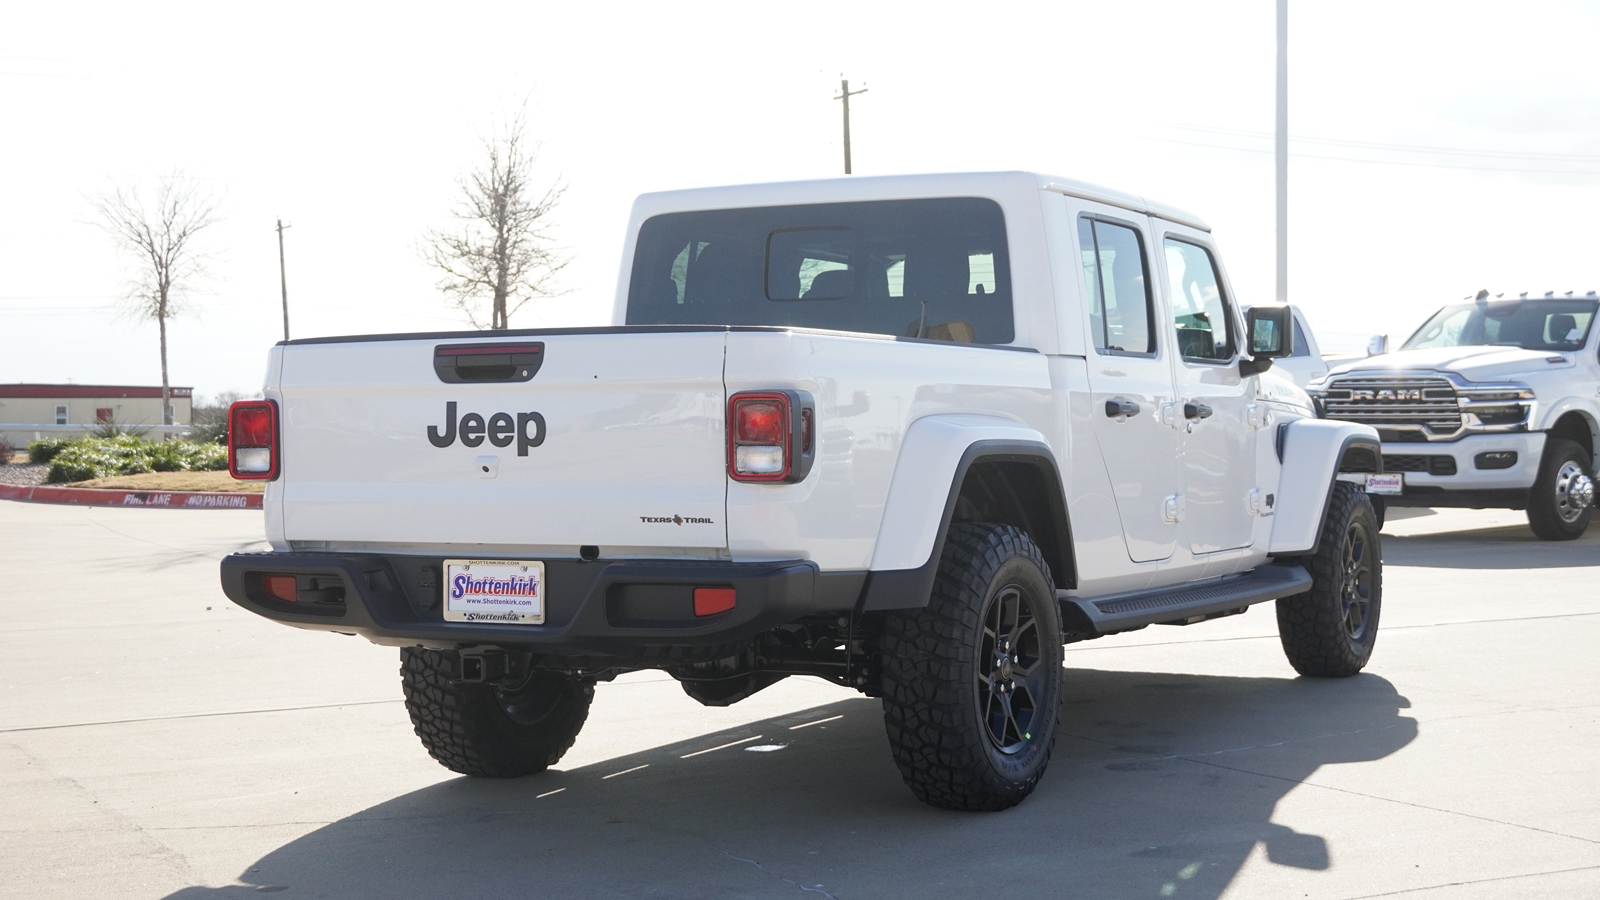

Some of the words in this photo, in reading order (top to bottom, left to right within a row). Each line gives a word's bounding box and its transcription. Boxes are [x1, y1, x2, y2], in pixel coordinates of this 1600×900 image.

[1353, 389, 1420, 400] RAM
[427, 401, 546, 457] Jeep
[146, 494, 172, 505] LANE
[187, 494, 202, 505] NO
[203, 495, 247, 507] PARKING
[452, 574, 539, 599] Shottenkirk
[466, 598, 532, 606] www.Shottenkirk.com
